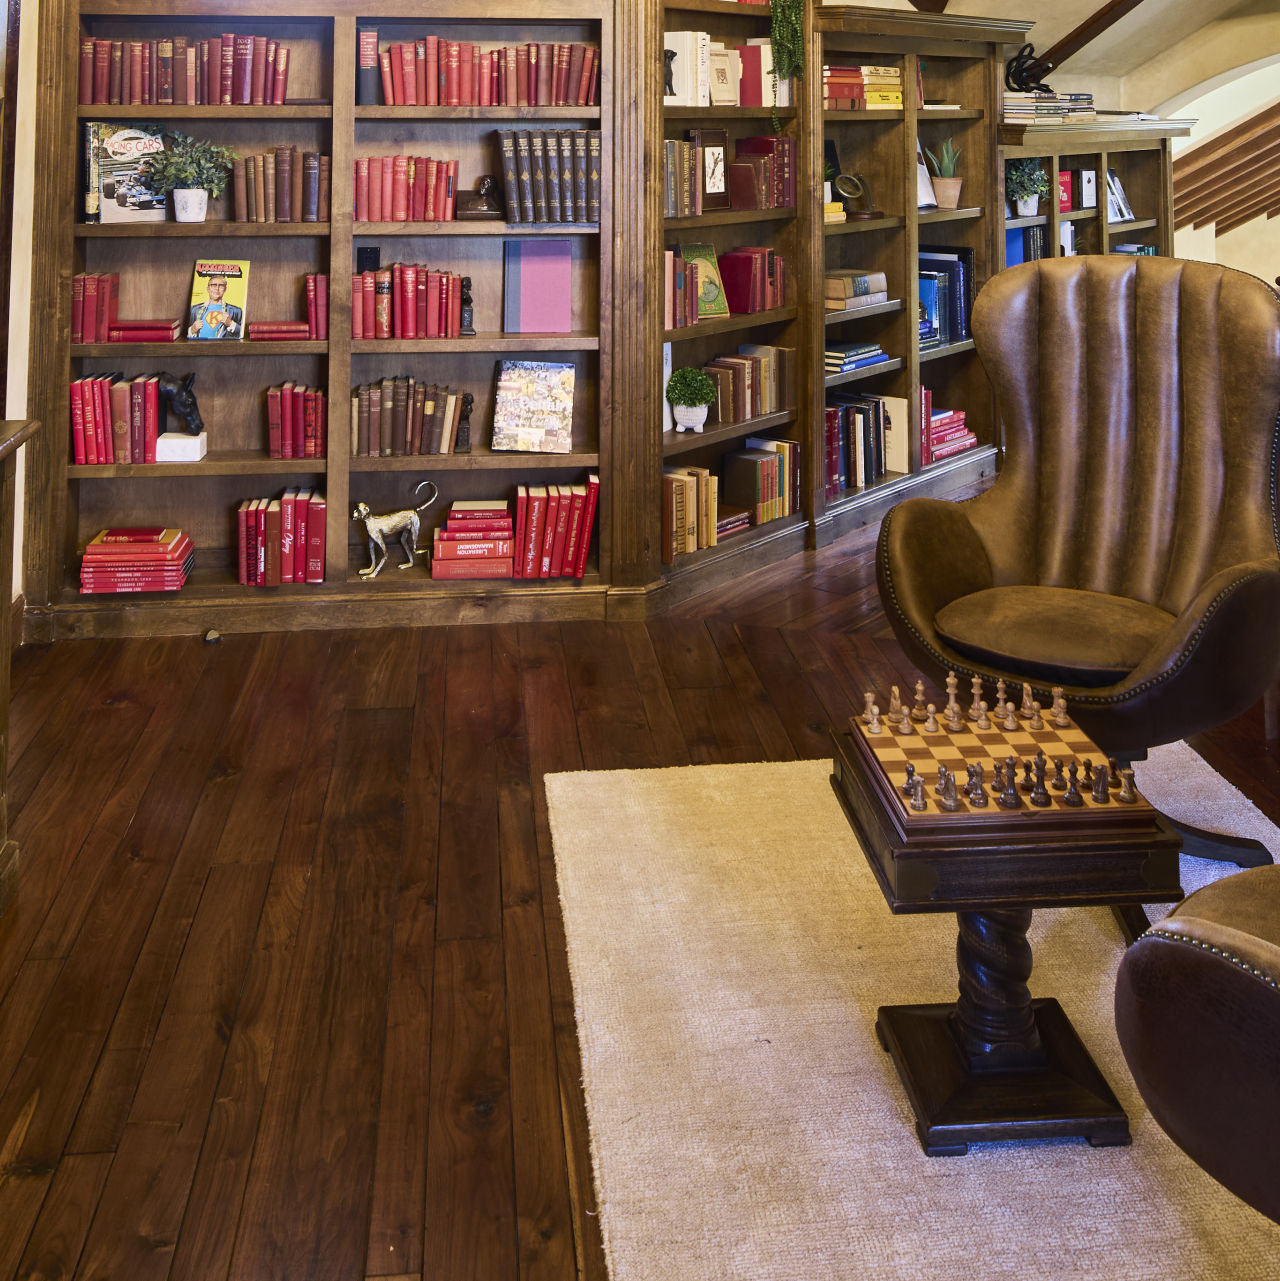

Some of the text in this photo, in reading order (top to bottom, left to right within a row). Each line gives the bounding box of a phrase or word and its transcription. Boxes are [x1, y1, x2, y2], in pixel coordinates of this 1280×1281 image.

[103, 137, 162, 153] RACING CARS
[209, 311, 221, 324] K
[457, 542, 494, 550] MANAGEMENT
